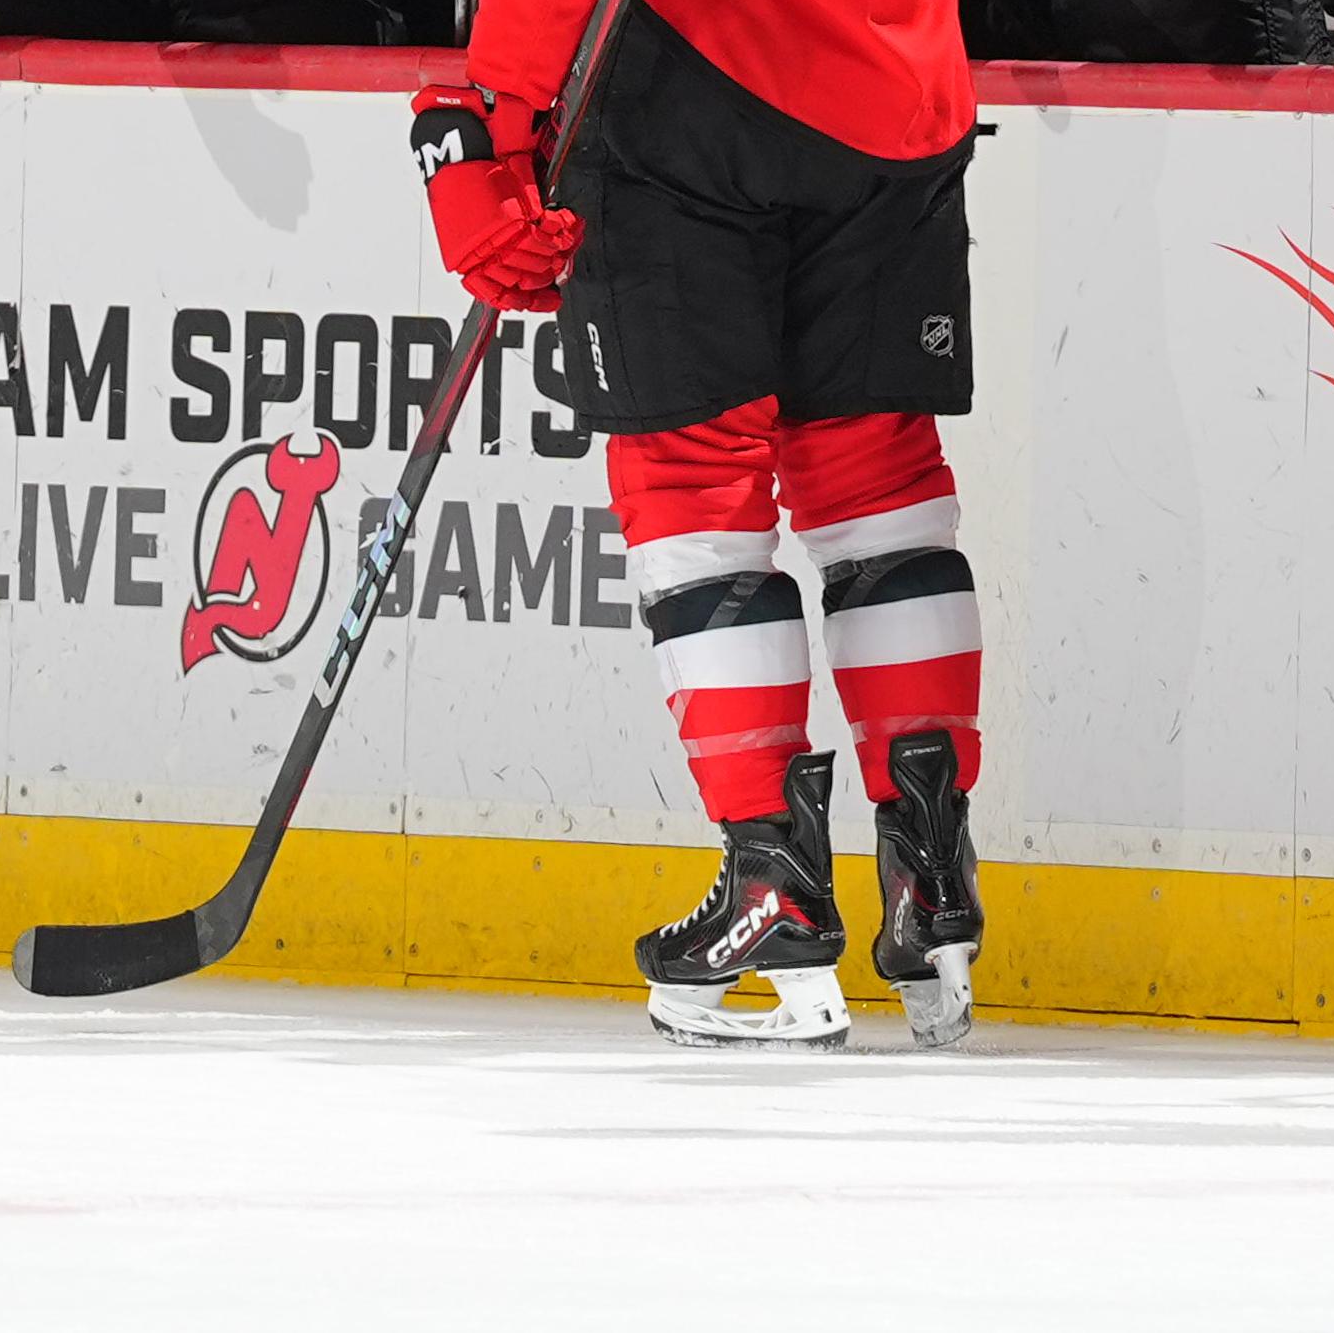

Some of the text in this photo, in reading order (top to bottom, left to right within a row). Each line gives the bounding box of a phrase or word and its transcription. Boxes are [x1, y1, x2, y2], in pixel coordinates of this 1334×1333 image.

[169, 308, 593, 459] SPORTS
[586, 321, 609, 392] CCM
[357, 497, 651, 631] GAME
[707, 889, 782, 968] CCM
[933, 909, 970, 922] CCM
